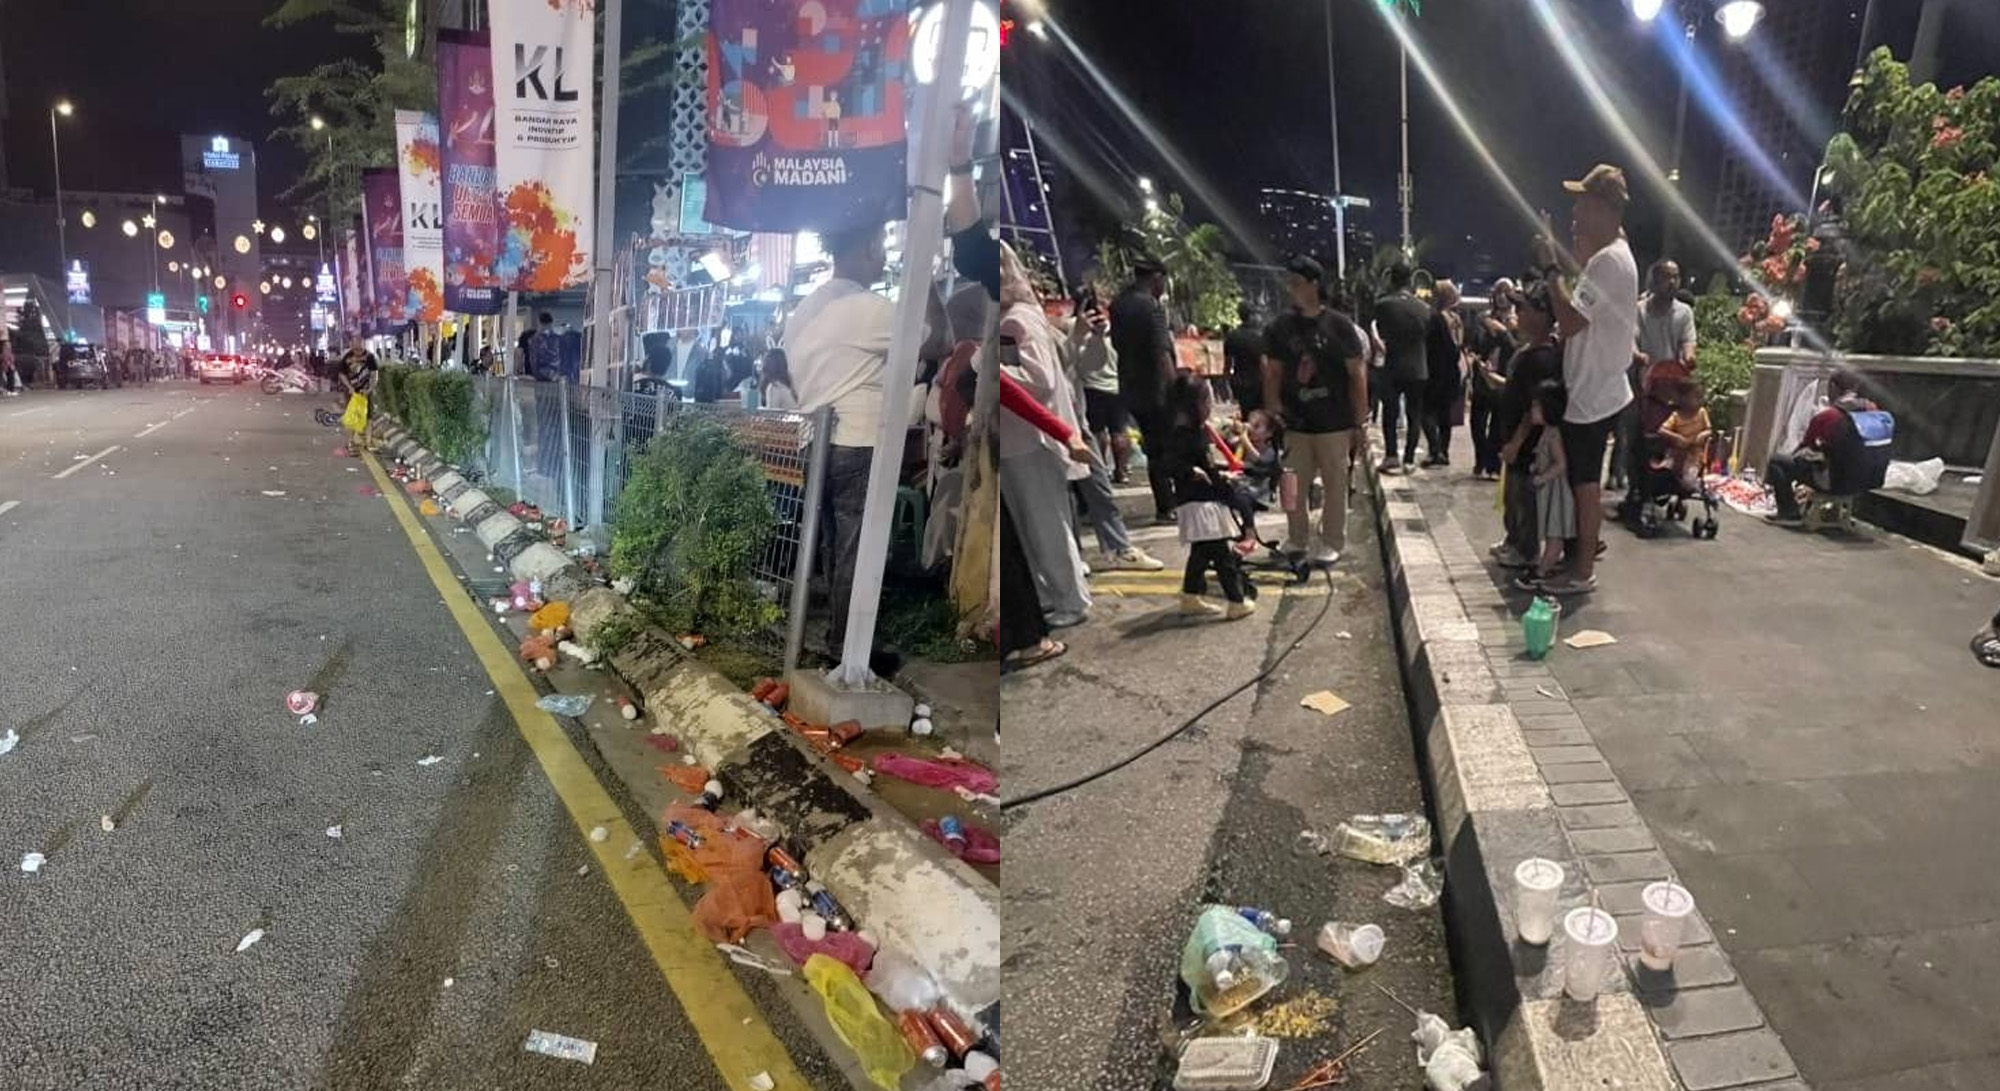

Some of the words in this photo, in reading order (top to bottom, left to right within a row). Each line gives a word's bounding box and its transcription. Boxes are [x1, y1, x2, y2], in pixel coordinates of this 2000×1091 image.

[514, 43, 579, 101] KL
[514, 115, 552, 124] BANDAR
[553, 117, 578, 125] RAYA
[774, 157, 845, 170] MALAYSIA
[774, 169, 846, 186] MADANI
[411, 202, 444, 229] KL
